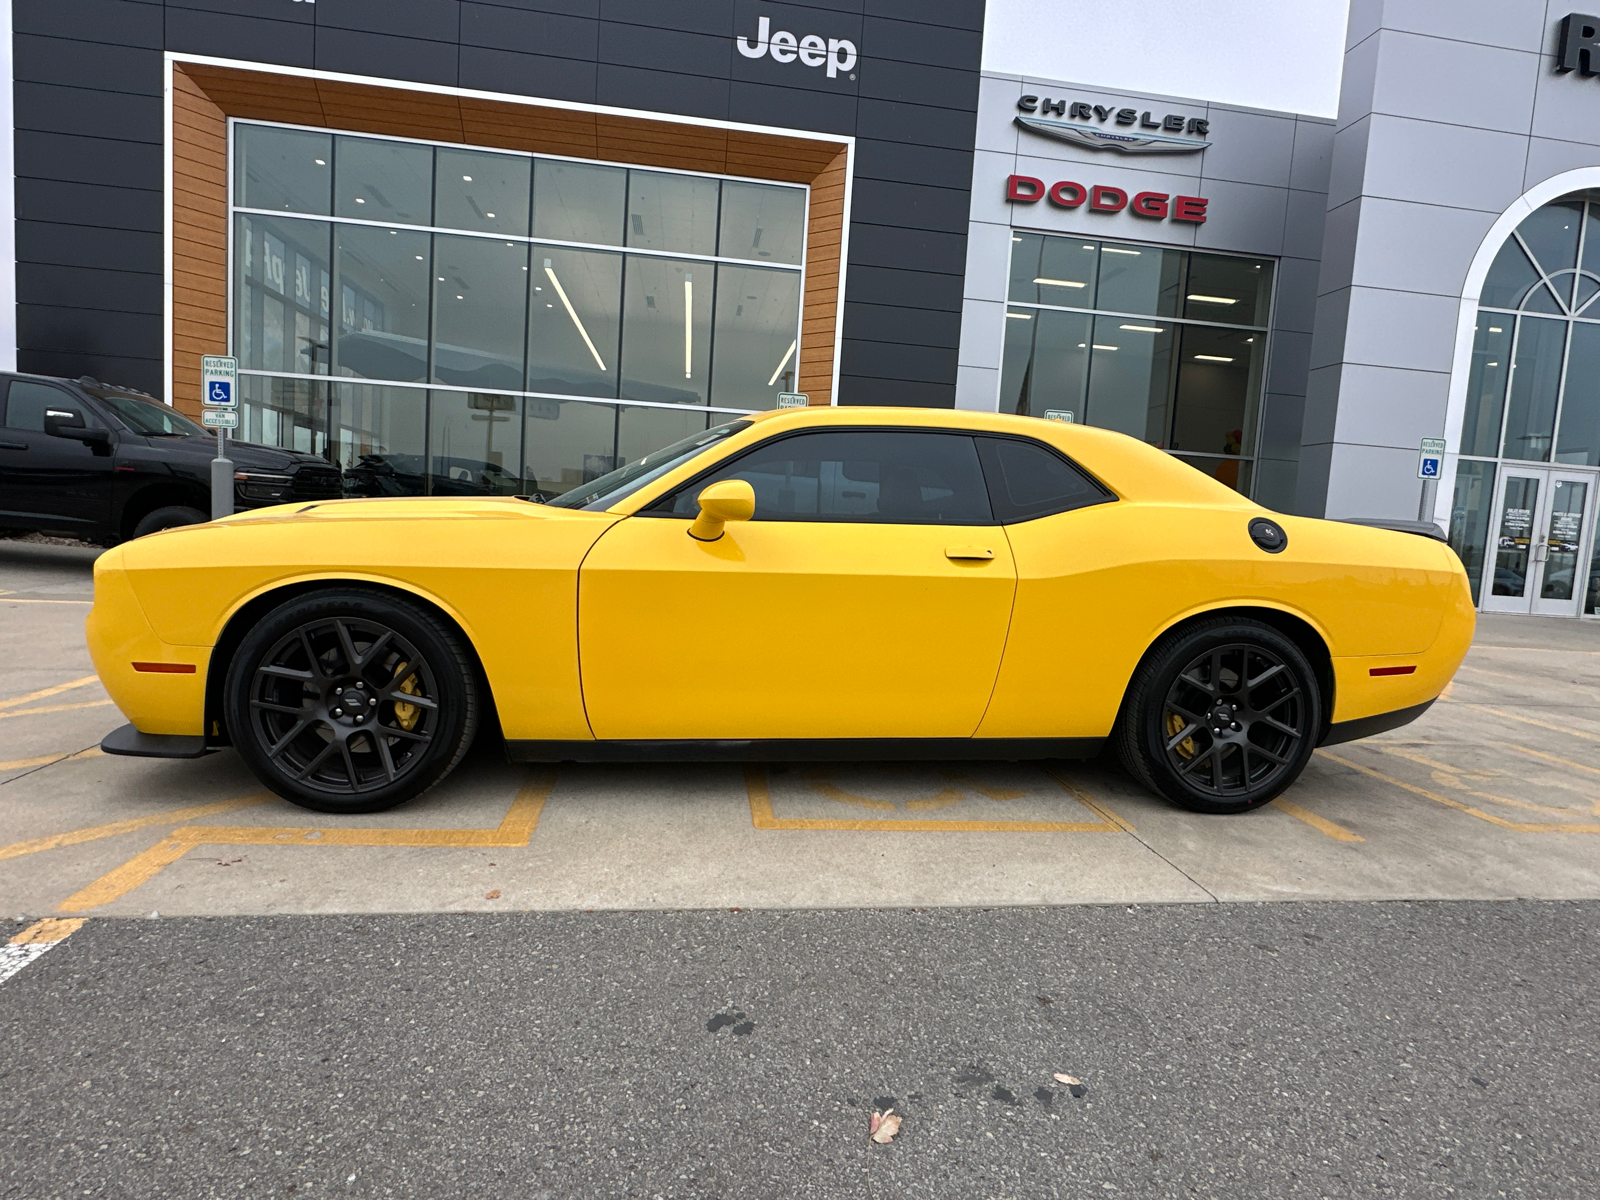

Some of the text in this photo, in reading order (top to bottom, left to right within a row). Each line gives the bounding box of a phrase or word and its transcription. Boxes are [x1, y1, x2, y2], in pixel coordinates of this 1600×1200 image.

[736, 16, 857, 78] Jeep
[1017, 95, 1209, 135] CHRYSLER
[1095, 133, 1133, 141] CHRYSLER
[1006, 174, 1209, 224] DODGE
[205, 360, 234, 369] RESERVED
[205, 369, 234, 377] PARKING
[781, 397, 805, 405] RESERVED
